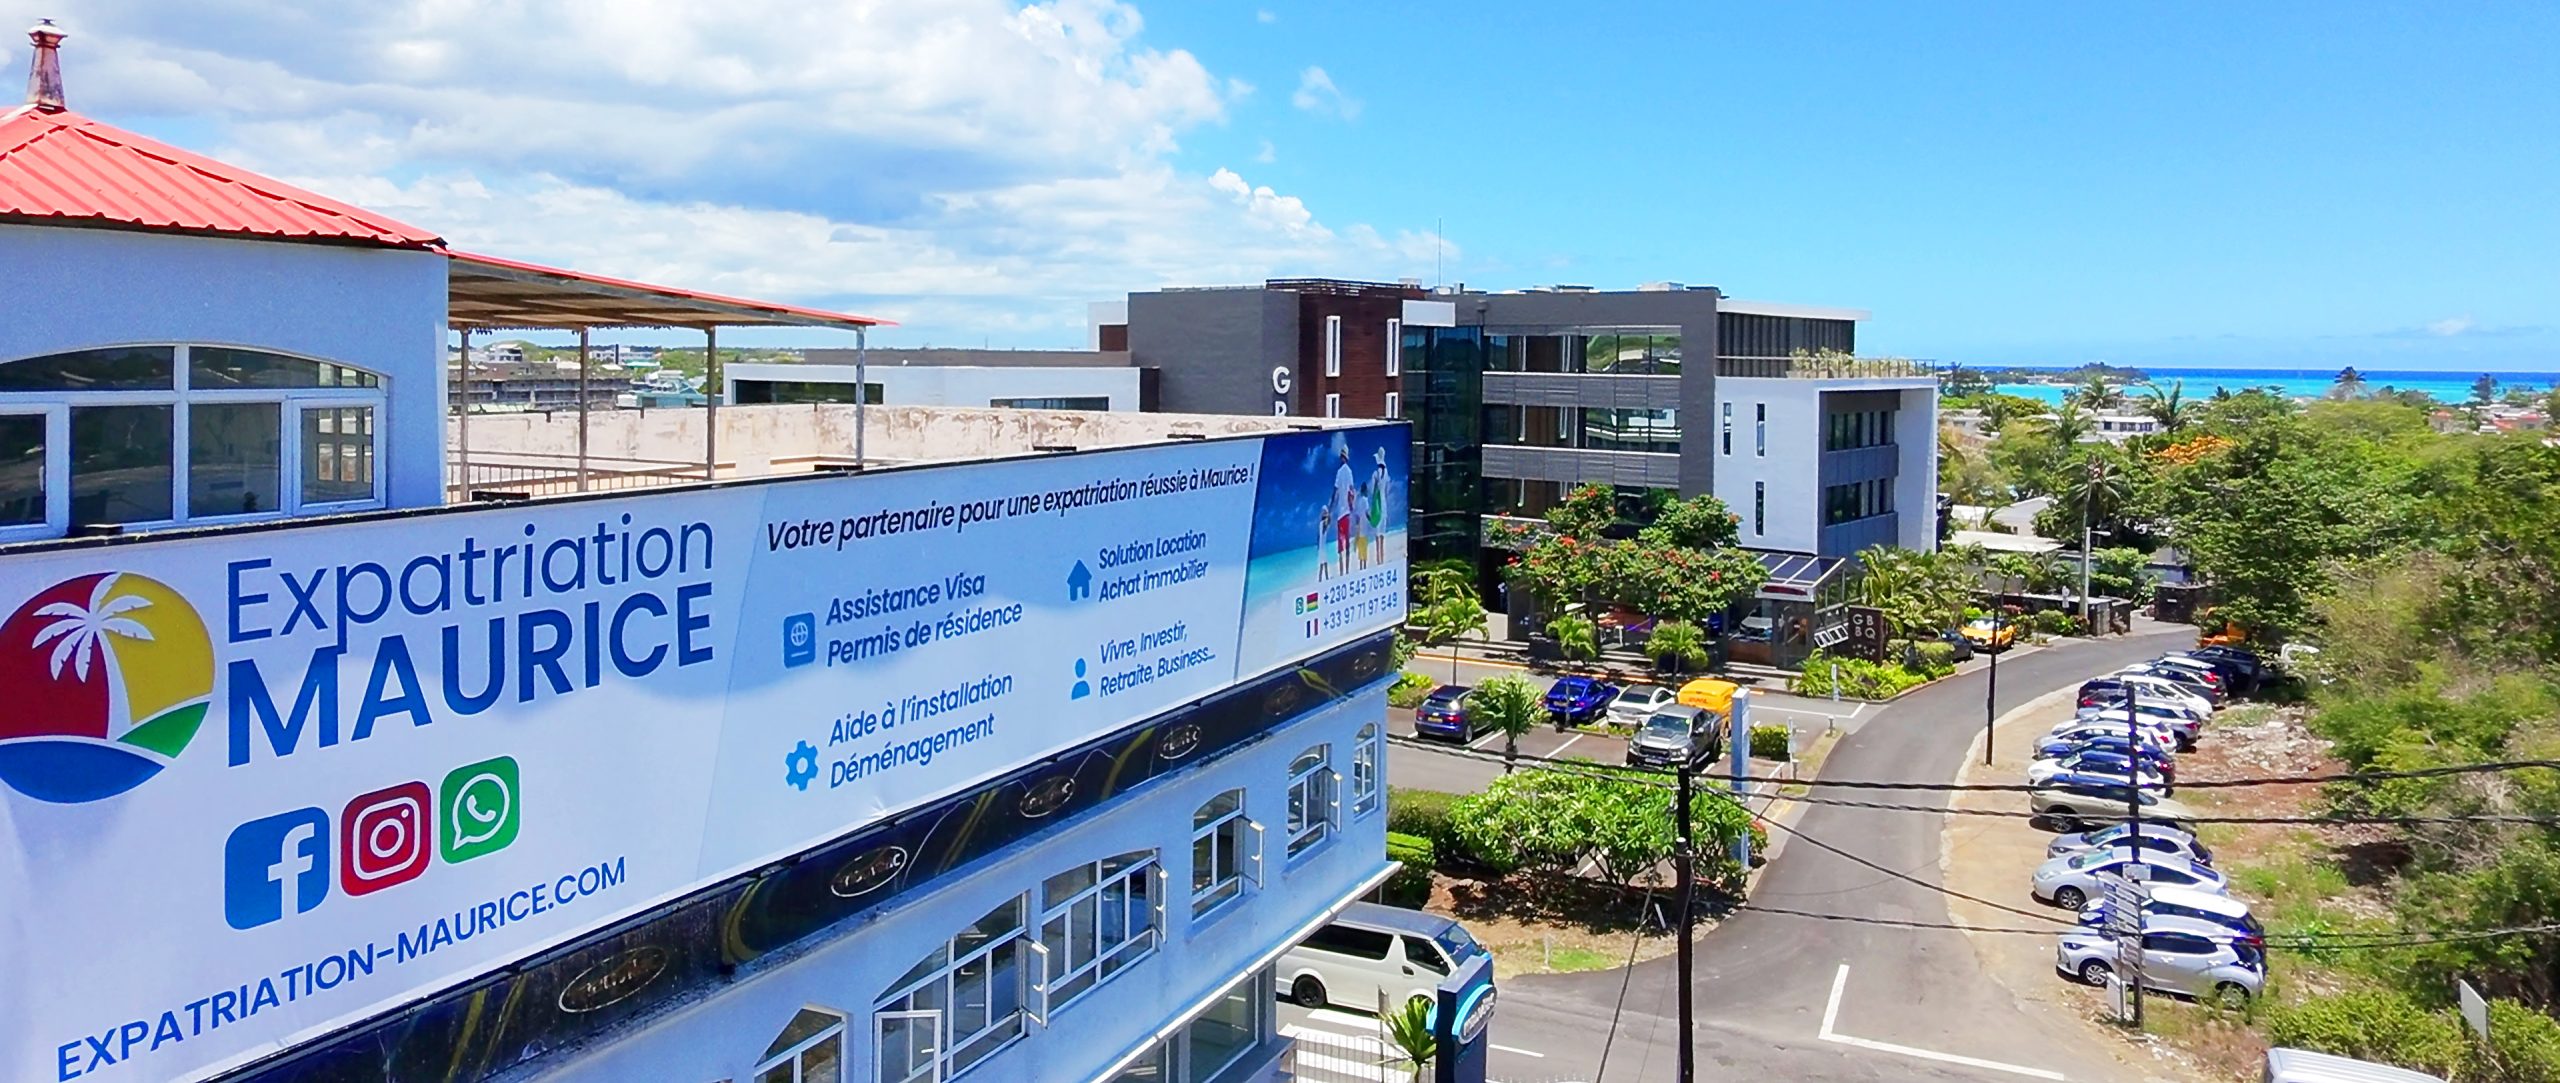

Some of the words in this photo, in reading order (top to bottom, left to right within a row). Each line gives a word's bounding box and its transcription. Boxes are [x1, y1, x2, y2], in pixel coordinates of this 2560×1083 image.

[767, 519, 834, 551] Votre
[837, 500, 955, 551] partenaire
[957, 497, 1005, 534] pour
[1007, 493, 1041, 517] une
[1044, 478, 1137, 517] expatriation
[1139, 471, 1188, 498] réussie
[1189, 468, 1198, 490] à
[1200, 464, 1248, 489] Maurice
[1099, 540, 1154, 569] Solution
[1156, 529, 1206, 558] Location
[227, 512, 714, 655] Expatriation
[825, 583, 941, 626] Assistance
[945, 572, 986, 601] Visa
[1099, 573, 1141, 602] Achat
[1143, 558, 1209, 591] immobilier
[1323, 583, 1347, 605] +230
[1349, 578, 1366, 598] 545
[1368, 571, 1385, 592] 706
[1386, 568, 1398, 587] 84
[827, 625, 900, 668] Permis
[904, 620, 931, 648] de
[935, 603, 1023, 641] résidence
[1323, 609, 1342, 630] +33
[1344, 605, 1355, 625] 97
[1357, 602, 1366, 620] 71
[1368, 597, 1379, 616] 97
[1381, 591, 1398, 612] 549
[1100, 640, 1137, 664] Vivre,
[1140, 620, 1188, 652] Investir,
[227, 581, 714, 768] MAURICE
[1100, 664, 1155, 698] Retraite,
[829, 710, 877, 747] Aide
[881, 702, 896, 730] à
[900, 673, 1013, 725] l'installation
[830, 712, 995, 790] Déménagement
[57, 856, 627, 1083] EXPATRIATION-MAURICE.COM
